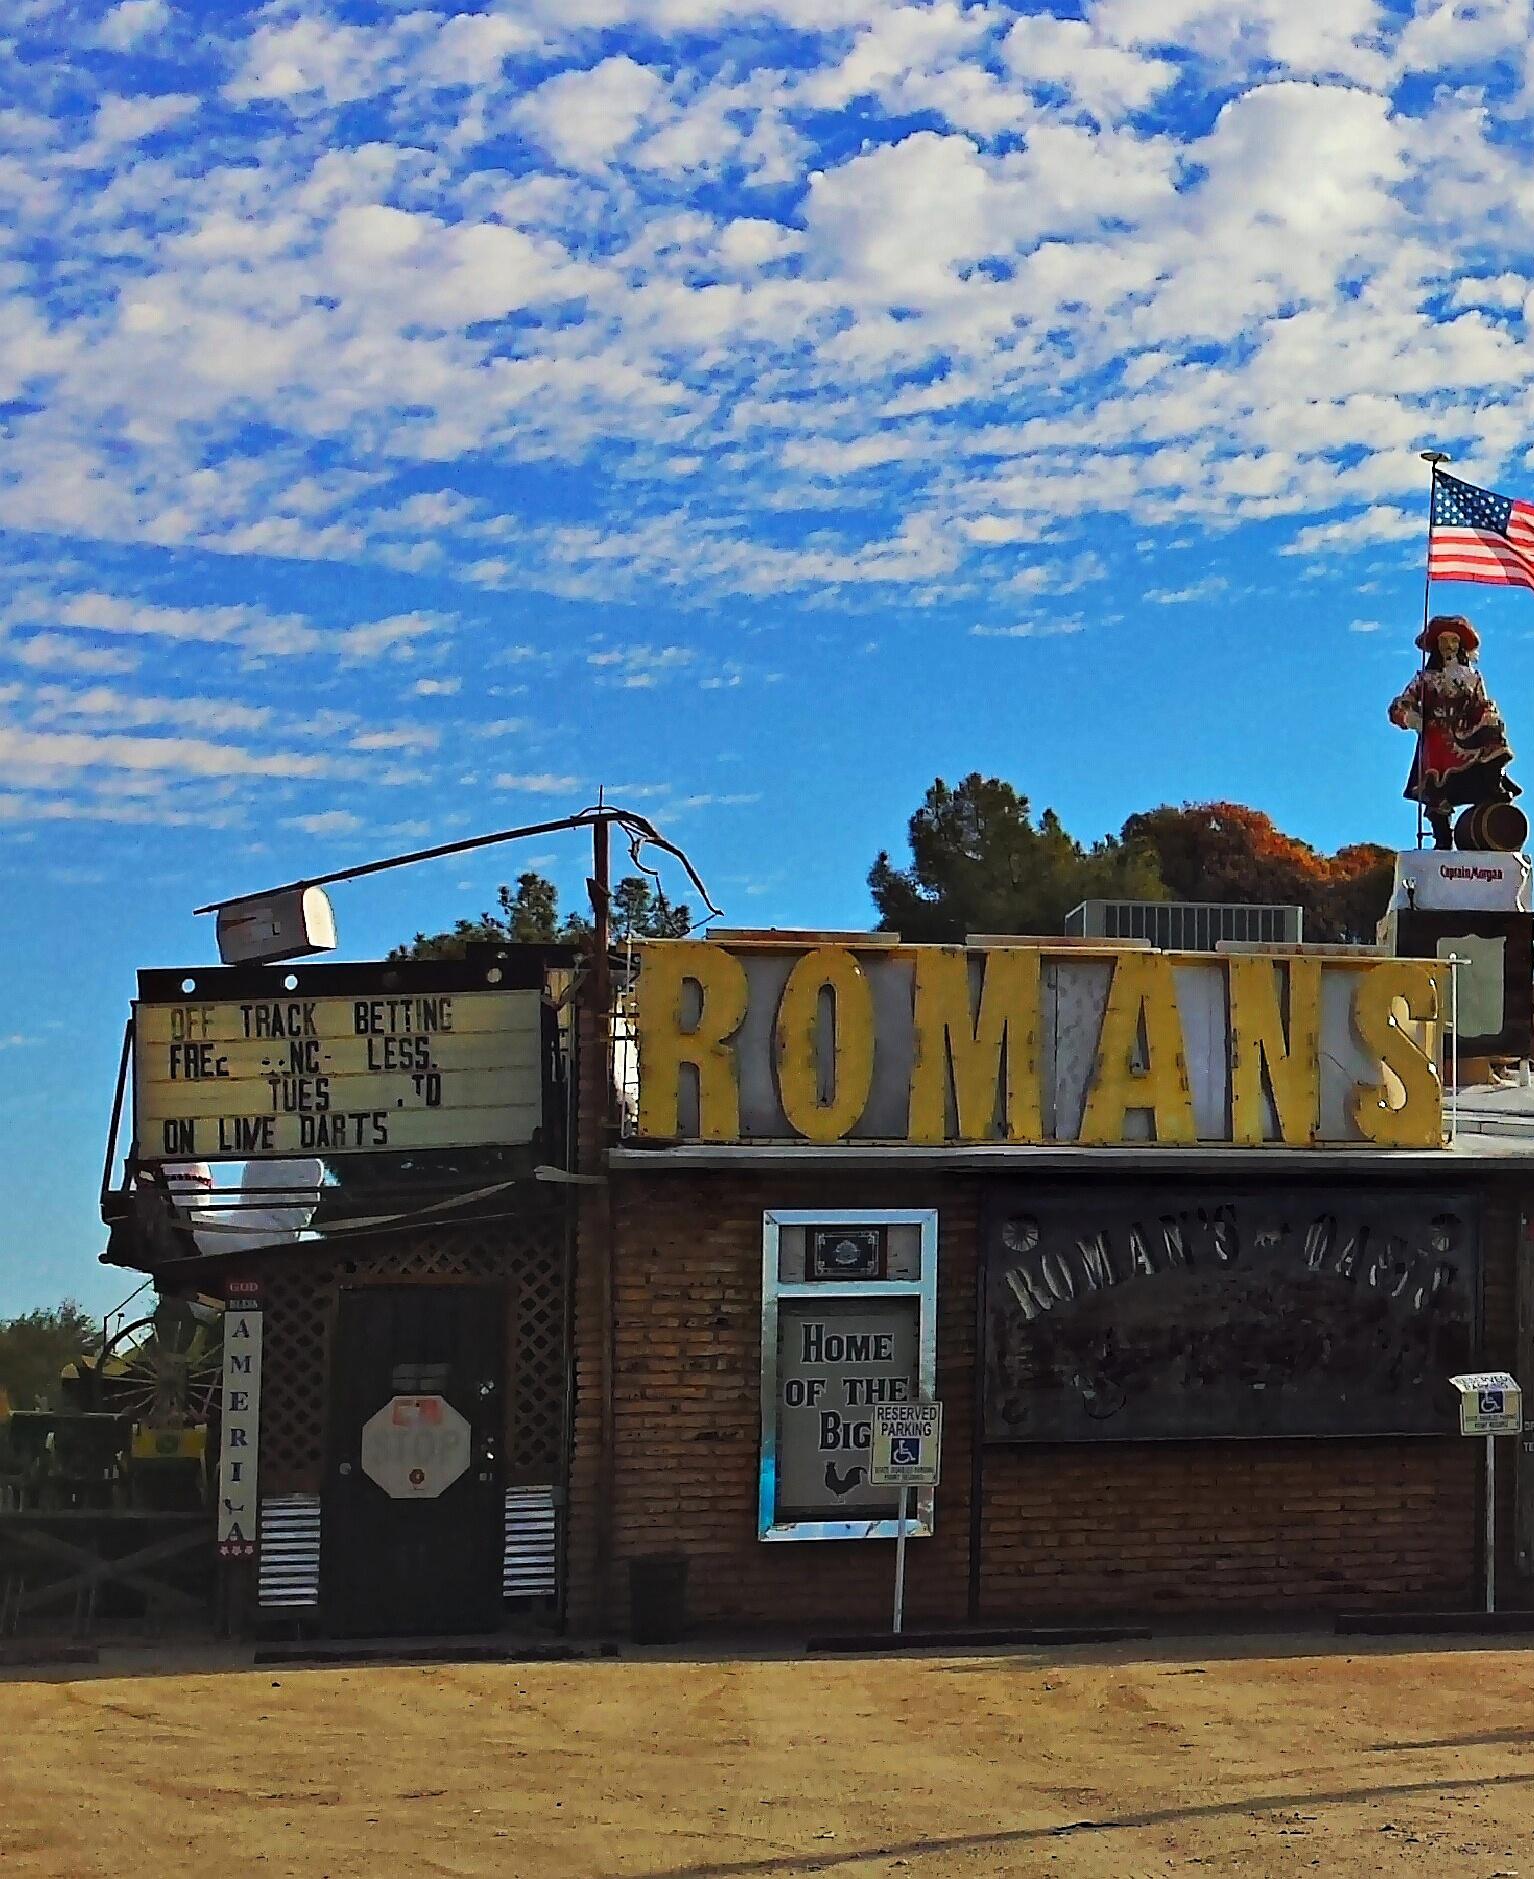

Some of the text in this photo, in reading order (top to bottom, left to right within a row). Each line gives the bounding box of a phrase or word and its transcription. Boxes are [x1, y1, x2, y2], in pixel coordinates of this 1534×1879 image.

[170, 997, 452, 1041] OFF TRACK BETTING
[639, 945, 1445, 1147] ROMANS
[268, 1077, 329, 1112] TUES
[162, 1111, 388, 1154] ON LIVE DARTS
[877, 1407, 937, 1421] RESERVED
[881, 1421, 932, 1436] PARKING
